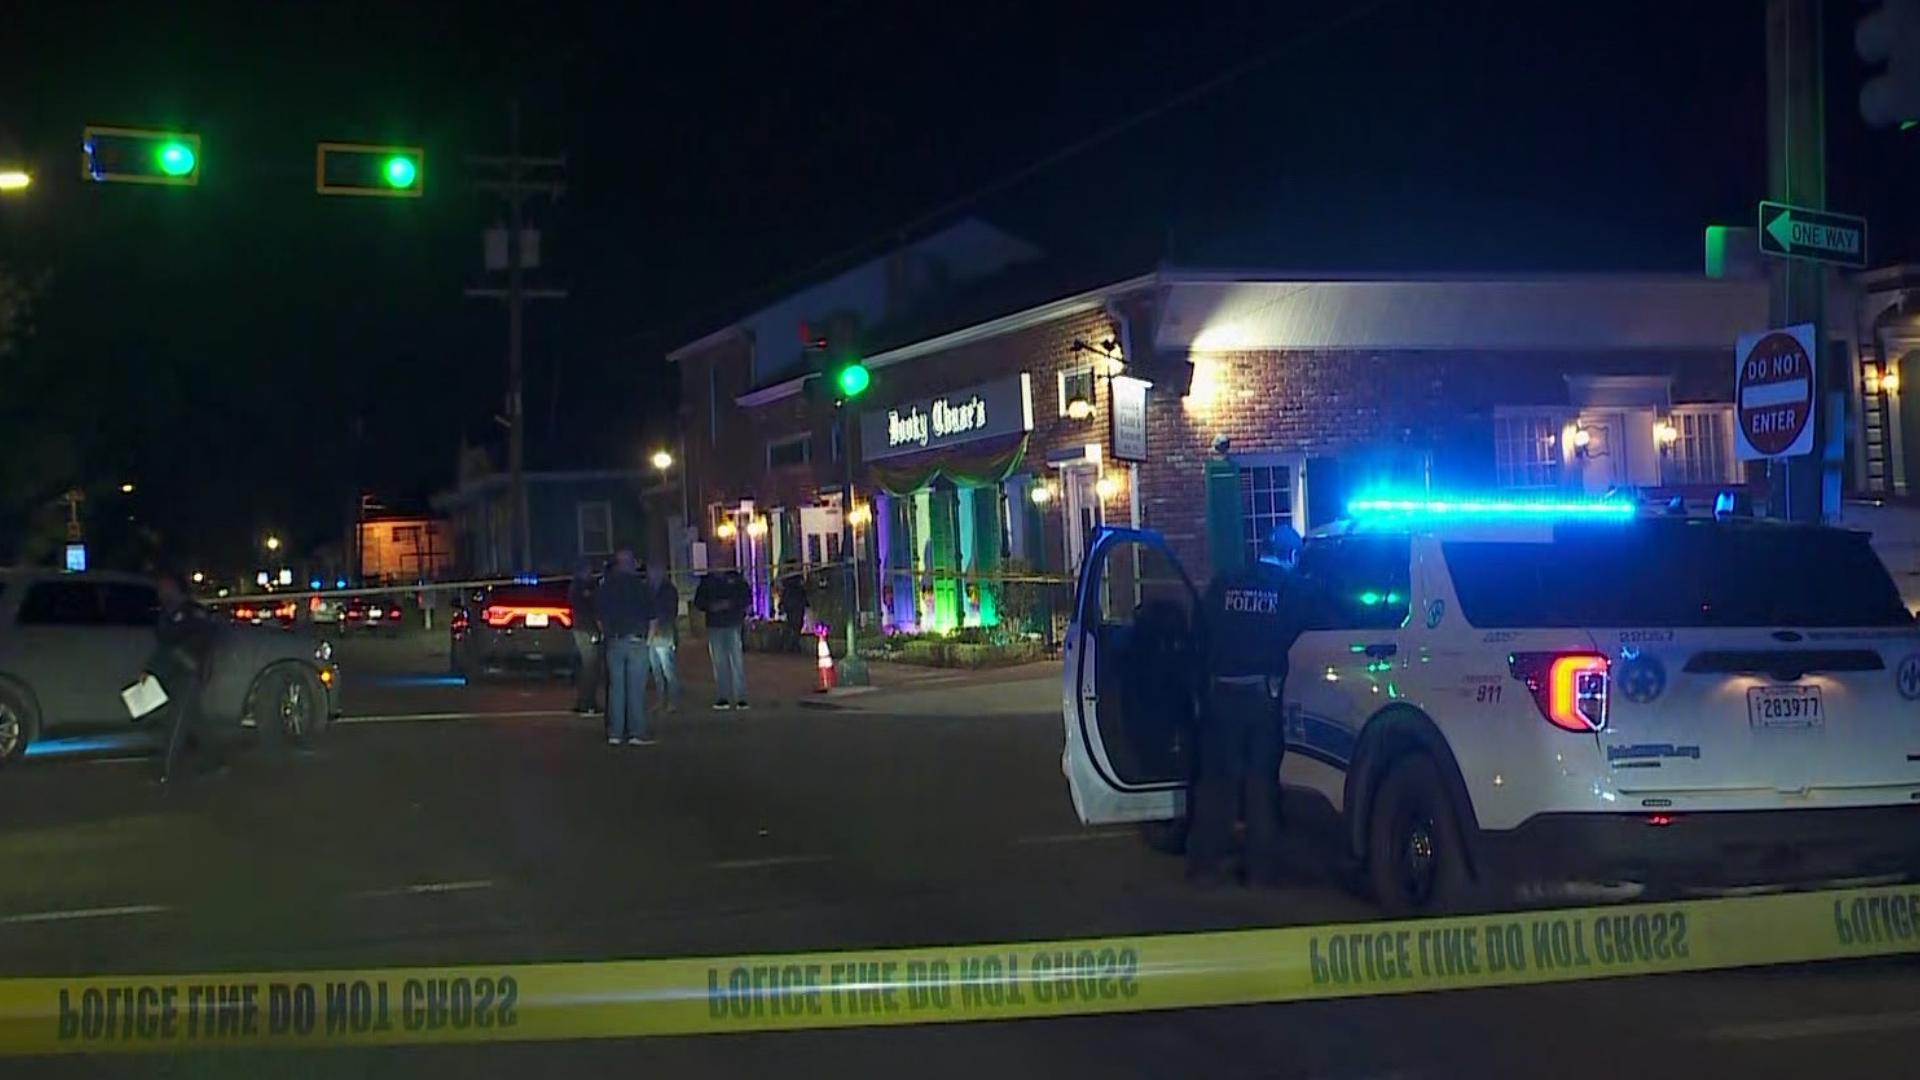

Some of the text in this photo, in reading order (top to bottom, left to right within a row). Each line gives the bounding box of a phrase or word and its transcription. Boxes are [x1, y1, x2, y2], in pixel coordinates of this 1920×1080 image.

[1792, 223, 1856, 250] ONE WAY
[1747, 354, 1802, 381] DO NOT
[1752, 410, 1796, 434] ENTER
[1476, 685, 1502, 703] 911
[1763, 697, 1818, 718] 283977
